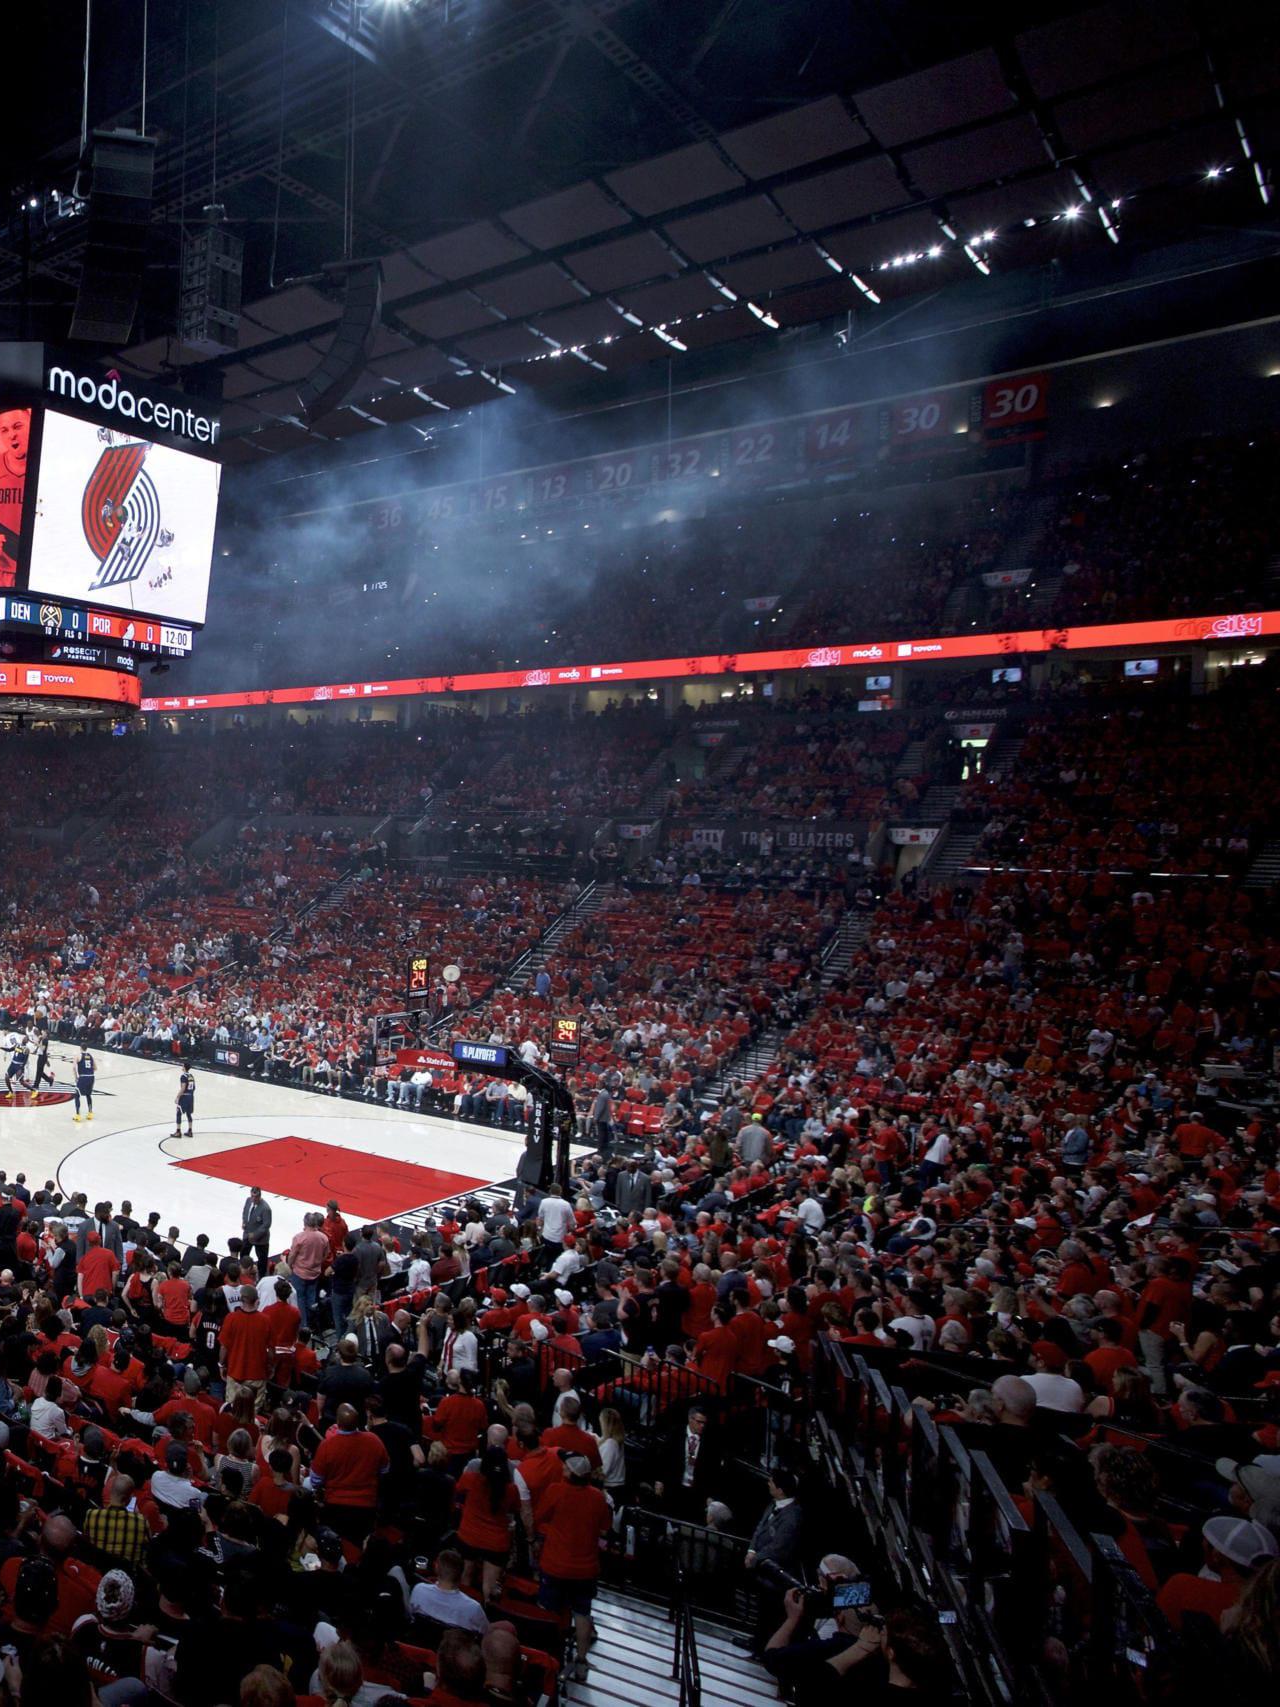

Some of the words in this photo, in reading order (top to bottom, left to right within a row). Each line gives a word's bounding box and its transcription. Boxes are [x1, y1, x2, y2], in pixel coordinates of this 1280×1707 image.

[989, 384, 1039, 418] 30
[897, 403, 940, 435] 30
[816, 419, 851, 450] 14
[736, 433, 775, 466] 22
[668, 449, 700, 477] 32
[599, 463, 632, 490] 20
[11, 602, 30, 621] DEN
[72, 612, 78, 629] 0
[93, 617, 110, 634] POR
[147, 626, 153, 642] 0
[166, 630, 187, 646] 12:00
[65, 630, 74, 638] FLS
[68, 654, 96, 662] PARTNERS
[853, 646, 882, 658] moda
[117, 655, 134, 667] moda
[43, 674, 74, 683] TOYOTA
[740, 831, 783, 846] TRL
[788, 832, 855, 847] BLAZERS
[412, 959, 427, 970] 12:00
[412, 971, 425, 988] 24
[559, 1020, 576, 1030] 12:00
[558, 1030, 573, 1040] 24
[468, 1047, 497, 1062] PLAYOFFS
[534, 1103, 542, 1125] NBA
[534, 1128, 541, 1143] TV
[206, 1331, 215, 1349] 0
